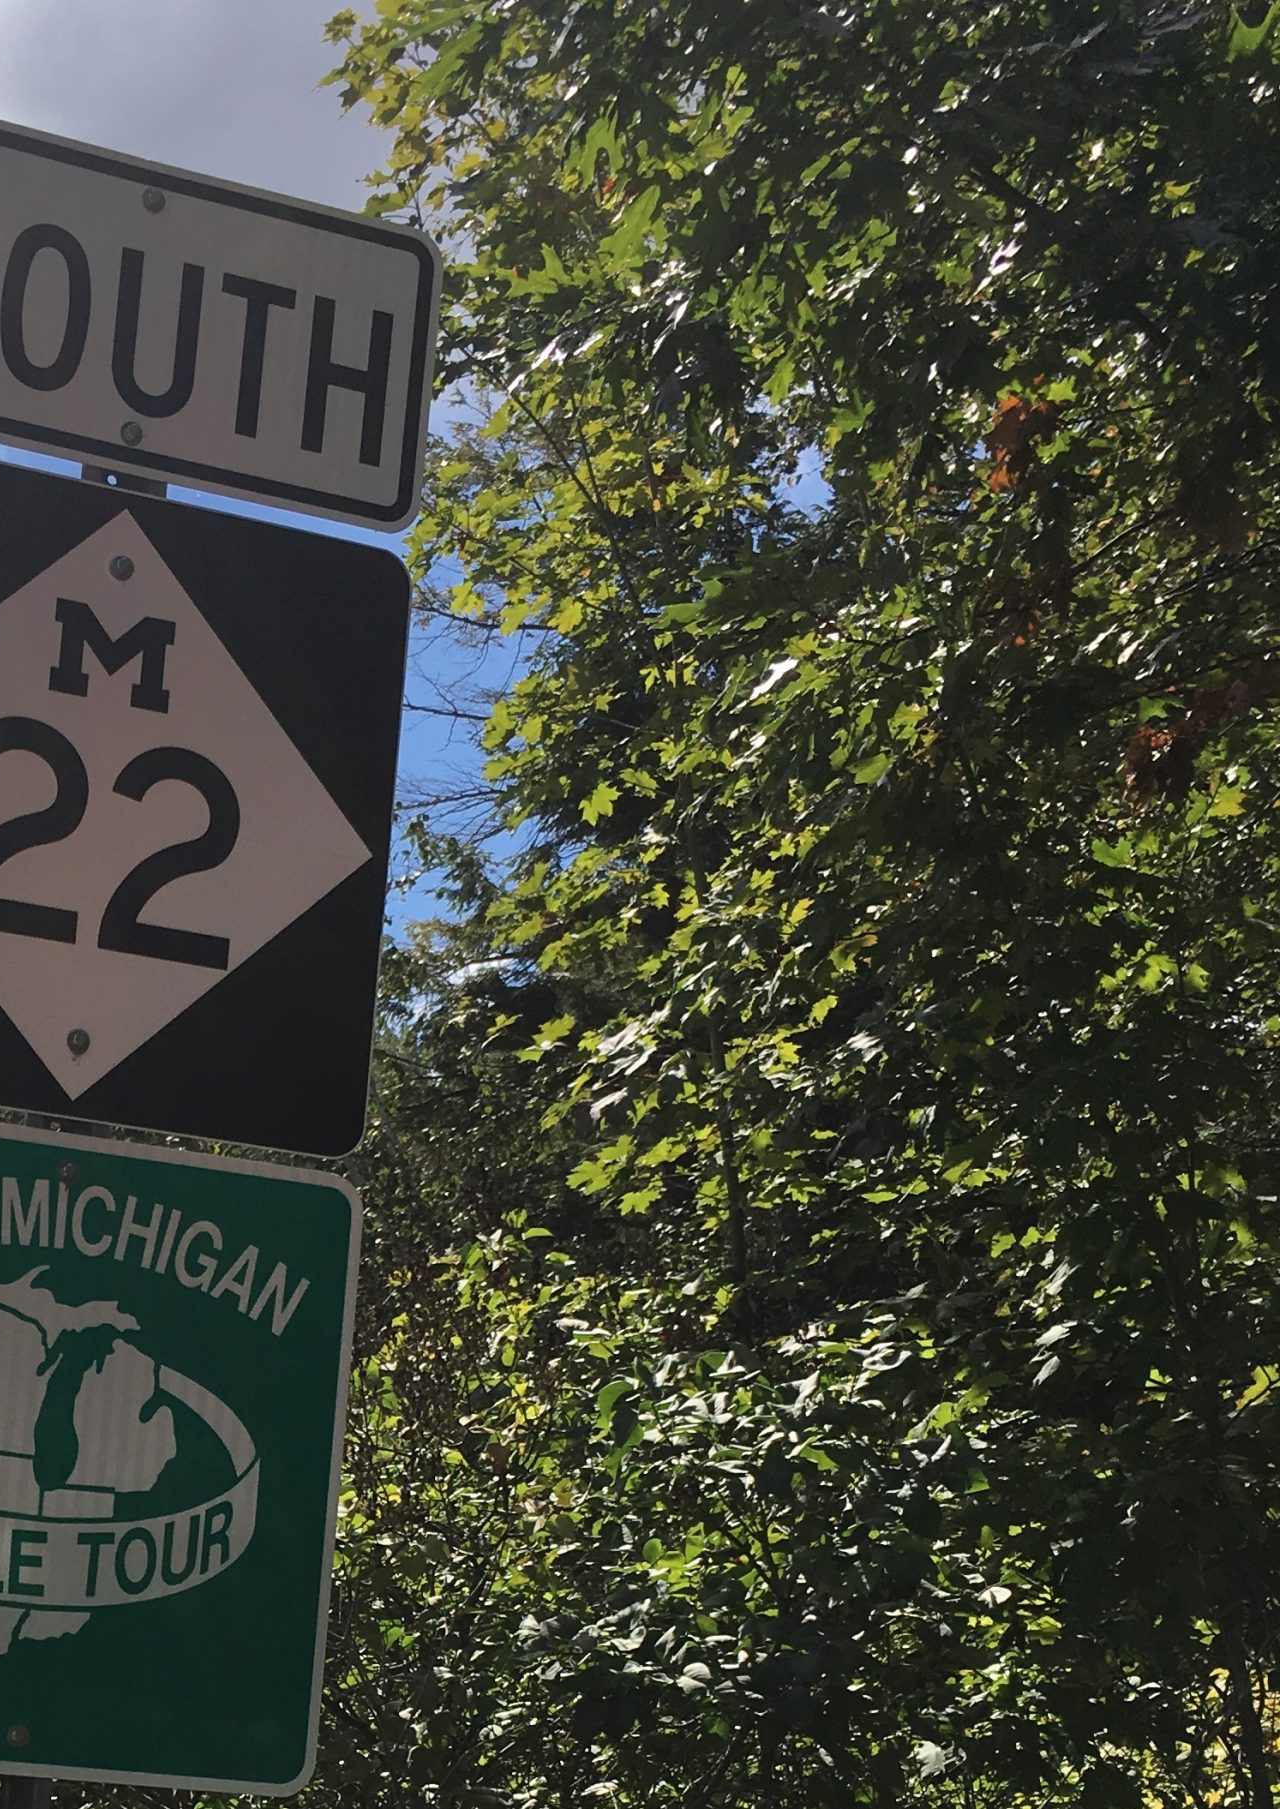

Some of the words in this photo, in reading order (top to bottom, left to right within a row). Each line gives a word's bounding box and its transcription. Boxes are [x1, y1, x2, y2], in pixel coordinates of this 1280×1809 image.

[49, 597, 176, 714] M
[1, 1177, 310, 1336] MICHIGAN
[77, 1500, 234, 1597] TOUR
